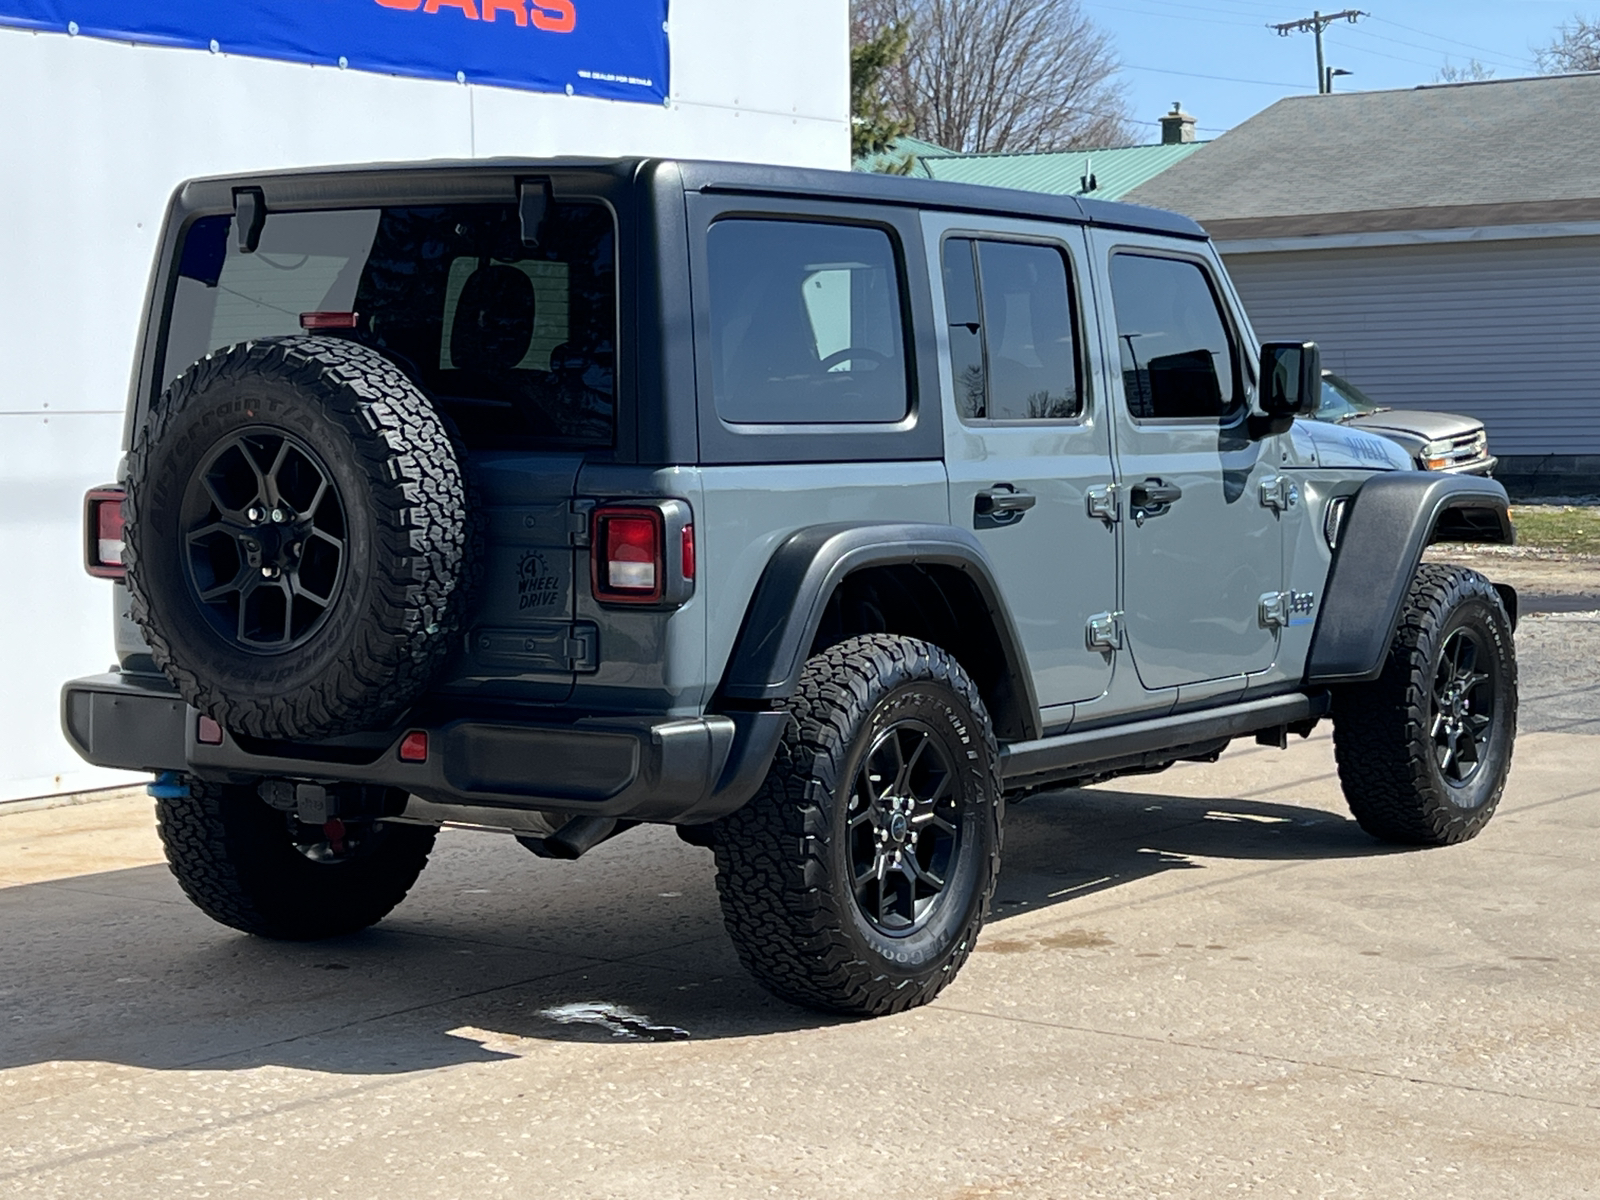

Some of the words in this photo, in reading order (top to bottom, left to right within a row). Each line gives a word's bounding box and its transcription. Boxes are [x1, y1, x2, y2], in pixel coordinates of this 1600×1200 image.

[375, 0, 576, 33] ARS
[524, 558, 537, 577] 4
[518, 576, 559, 595] WHEEL
[519, 591, 559, 610] DRIVE
